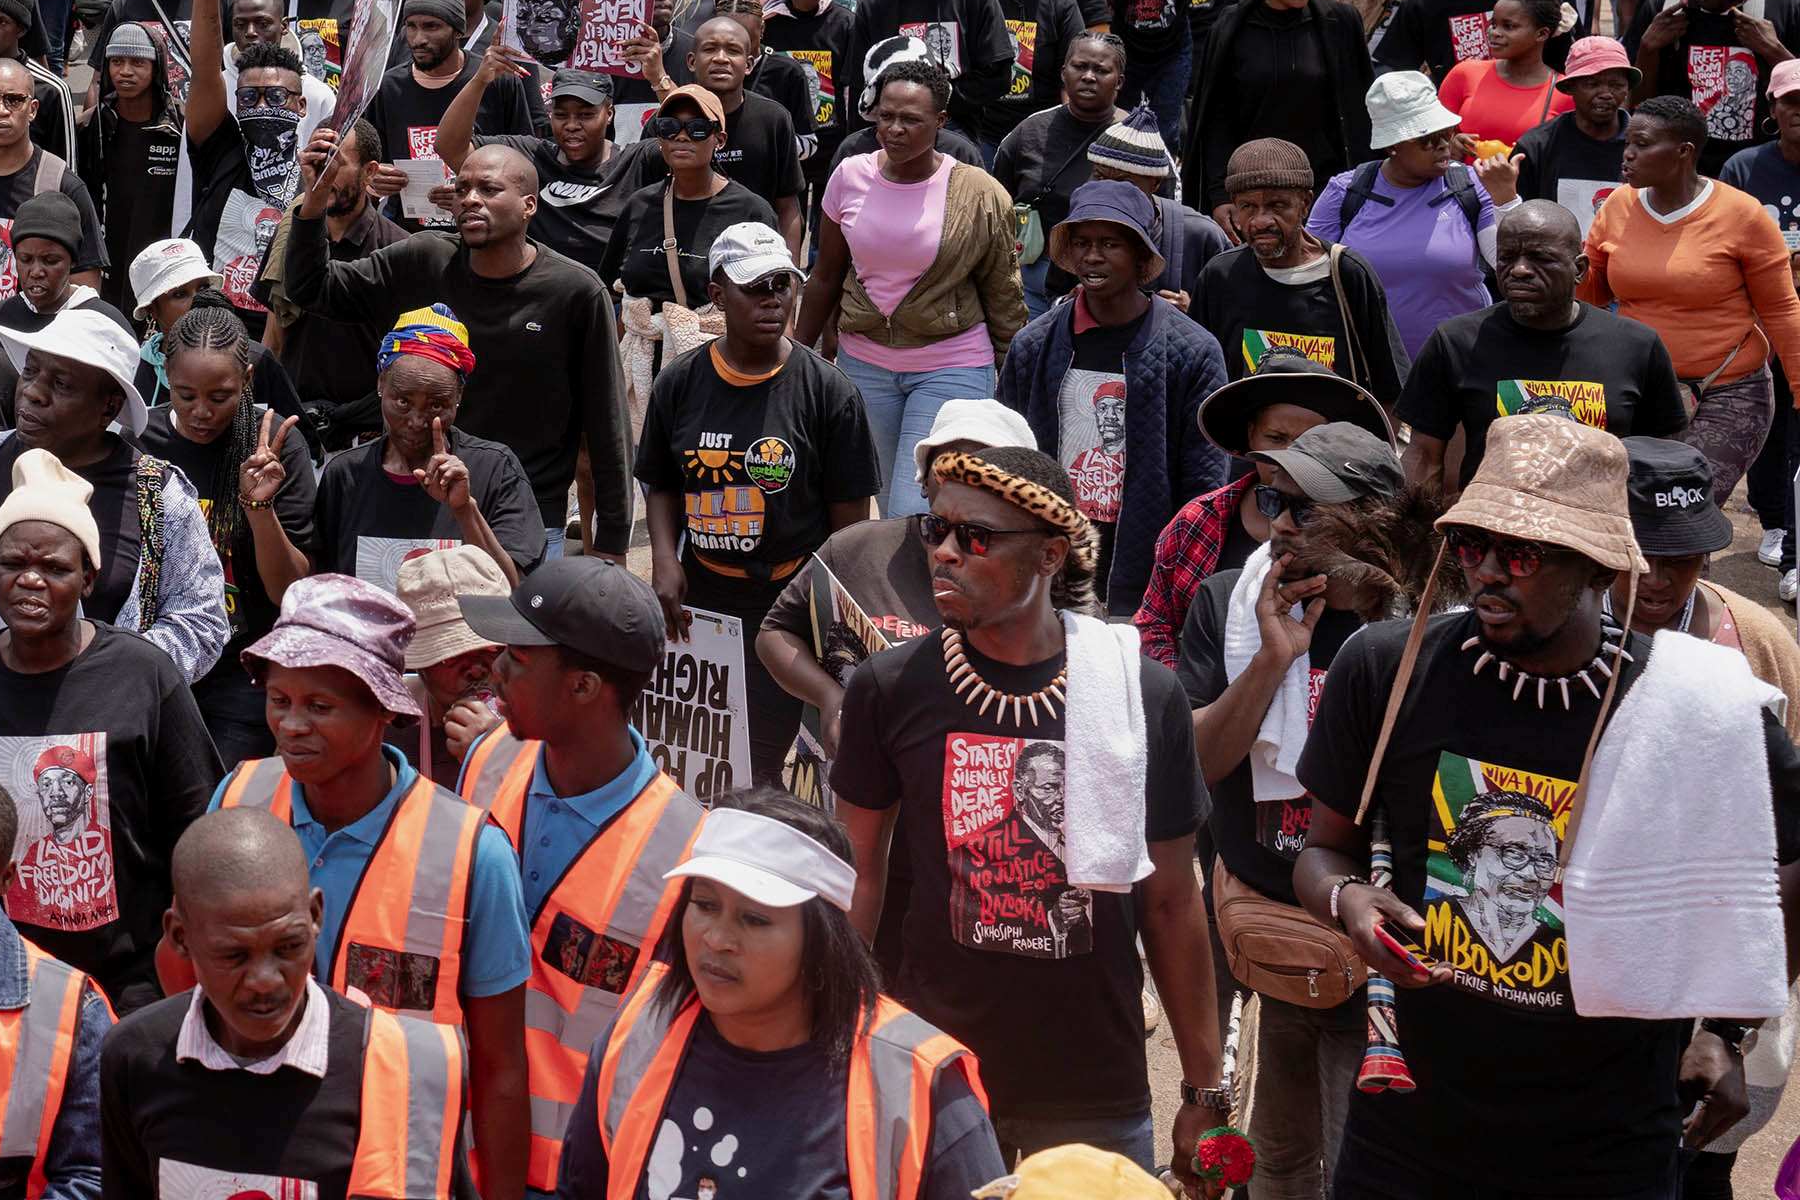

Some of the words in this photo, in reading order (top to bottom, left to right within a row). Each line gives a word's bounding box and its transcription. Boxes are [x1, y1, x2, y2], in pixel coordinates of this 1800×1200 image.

[1267, 331, 1288, 345] VIVA
[1524, 380, 1548, 396] VIVA
[699, 431, 733, 449] JUST
[648, 651, 730, 711] RIGH
[951, 738, 1017, 769] STATE'S
[998, 769, 1009, 787] IS
[1484, 765, 1523, 791] VIVA
[950, 788, 1009, 819] DEAF-
[952, 805, 1005, 837] ENING
[35, 830, 105, 868] LAND
[966, 820, 1033, 868] STILL
[15, 850, 111, 890] FREEDOM
[969, 870, 993, 890] NO
[991, 849, 1057, 885] JUSTICE
[1018, 872, 1066, 895] FOR
[37, 873, 114, 910] DIGNITY
[976, 886, 1050, 929] BAZOOKA
[972, 921, 1023, 945] SIKHOSIPHI
[1012, 936, 1053, 952] RADEBE
[1424, 900, 1568, 989] MBOKODO
[1493, 983, 1564, 1008] NTSHANGASE
